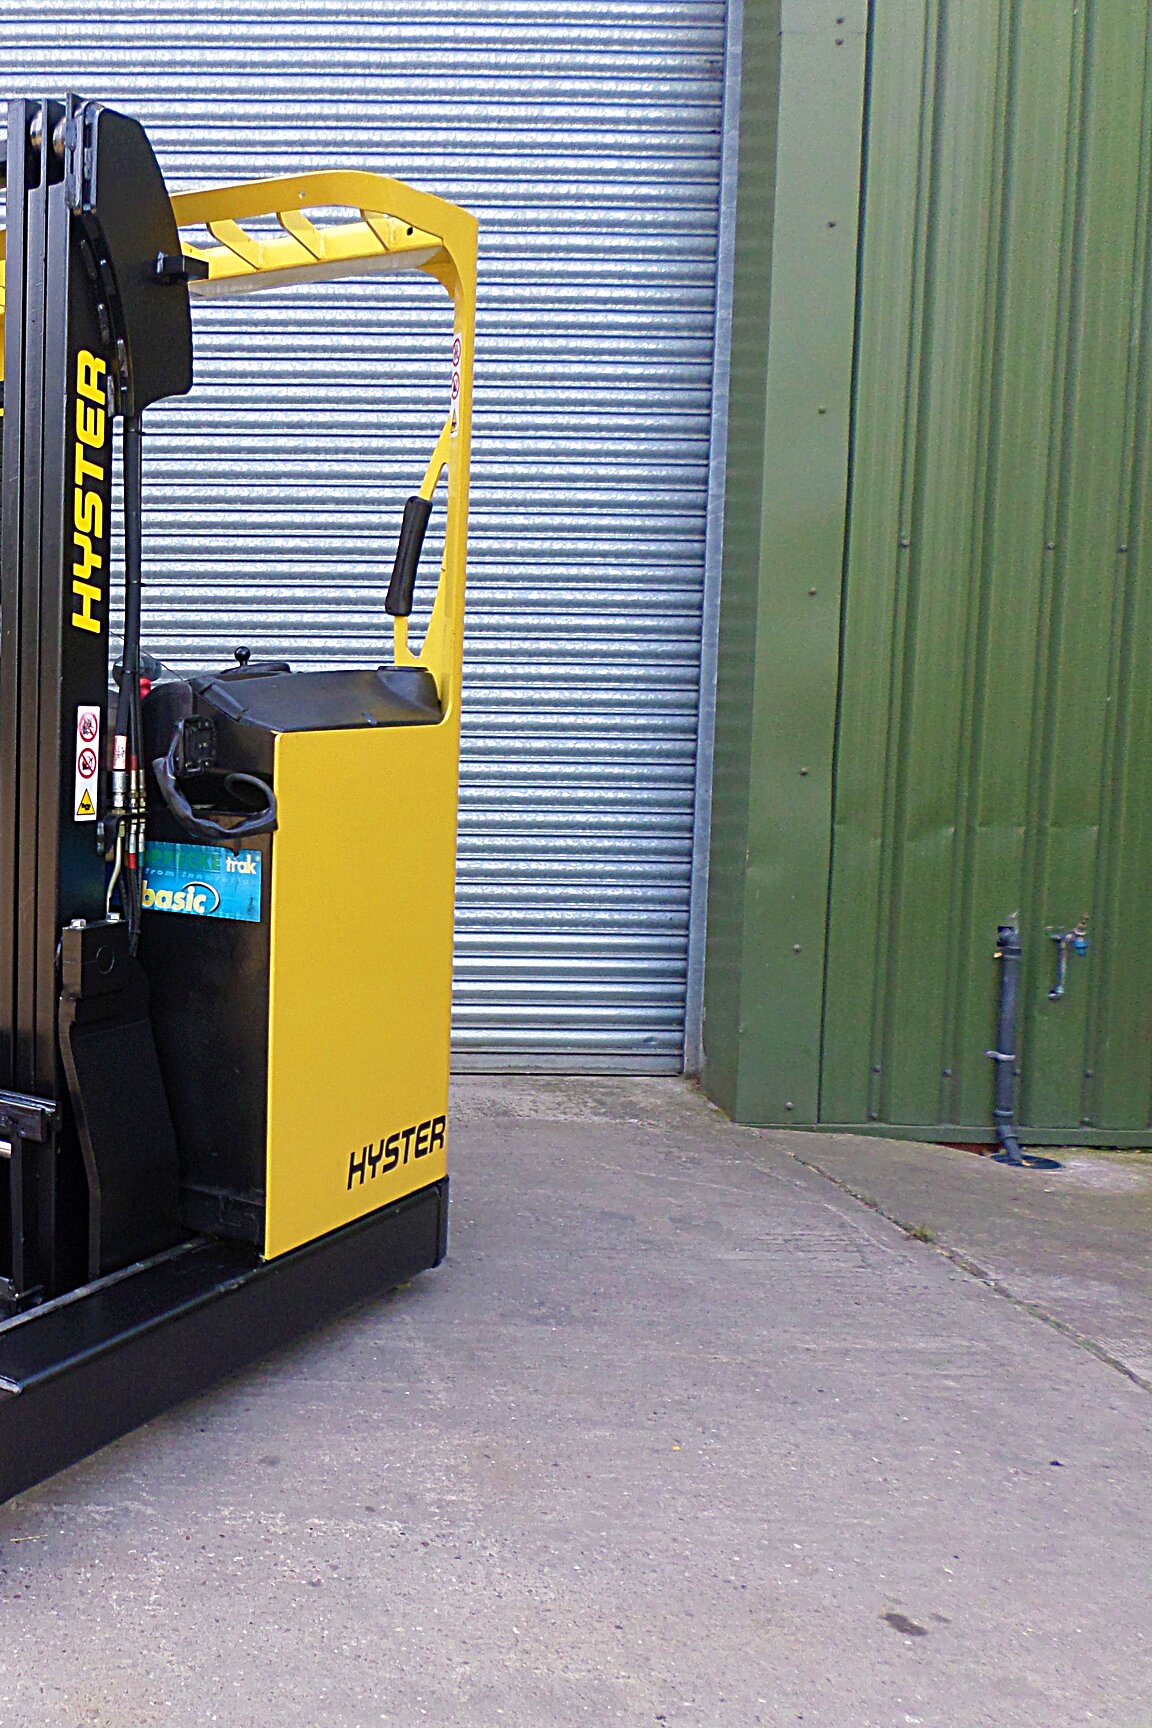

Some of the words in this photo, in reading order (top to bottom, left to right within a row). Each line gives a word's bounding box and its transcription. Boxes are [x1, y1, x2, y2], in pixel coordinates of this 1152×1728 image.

[72, 349, 106, 633] HYSTER
[226, 854, 256, 875] trak
[142, 880, 207, 914] basic
[347, 1115, 446, 1191] HYSTER
